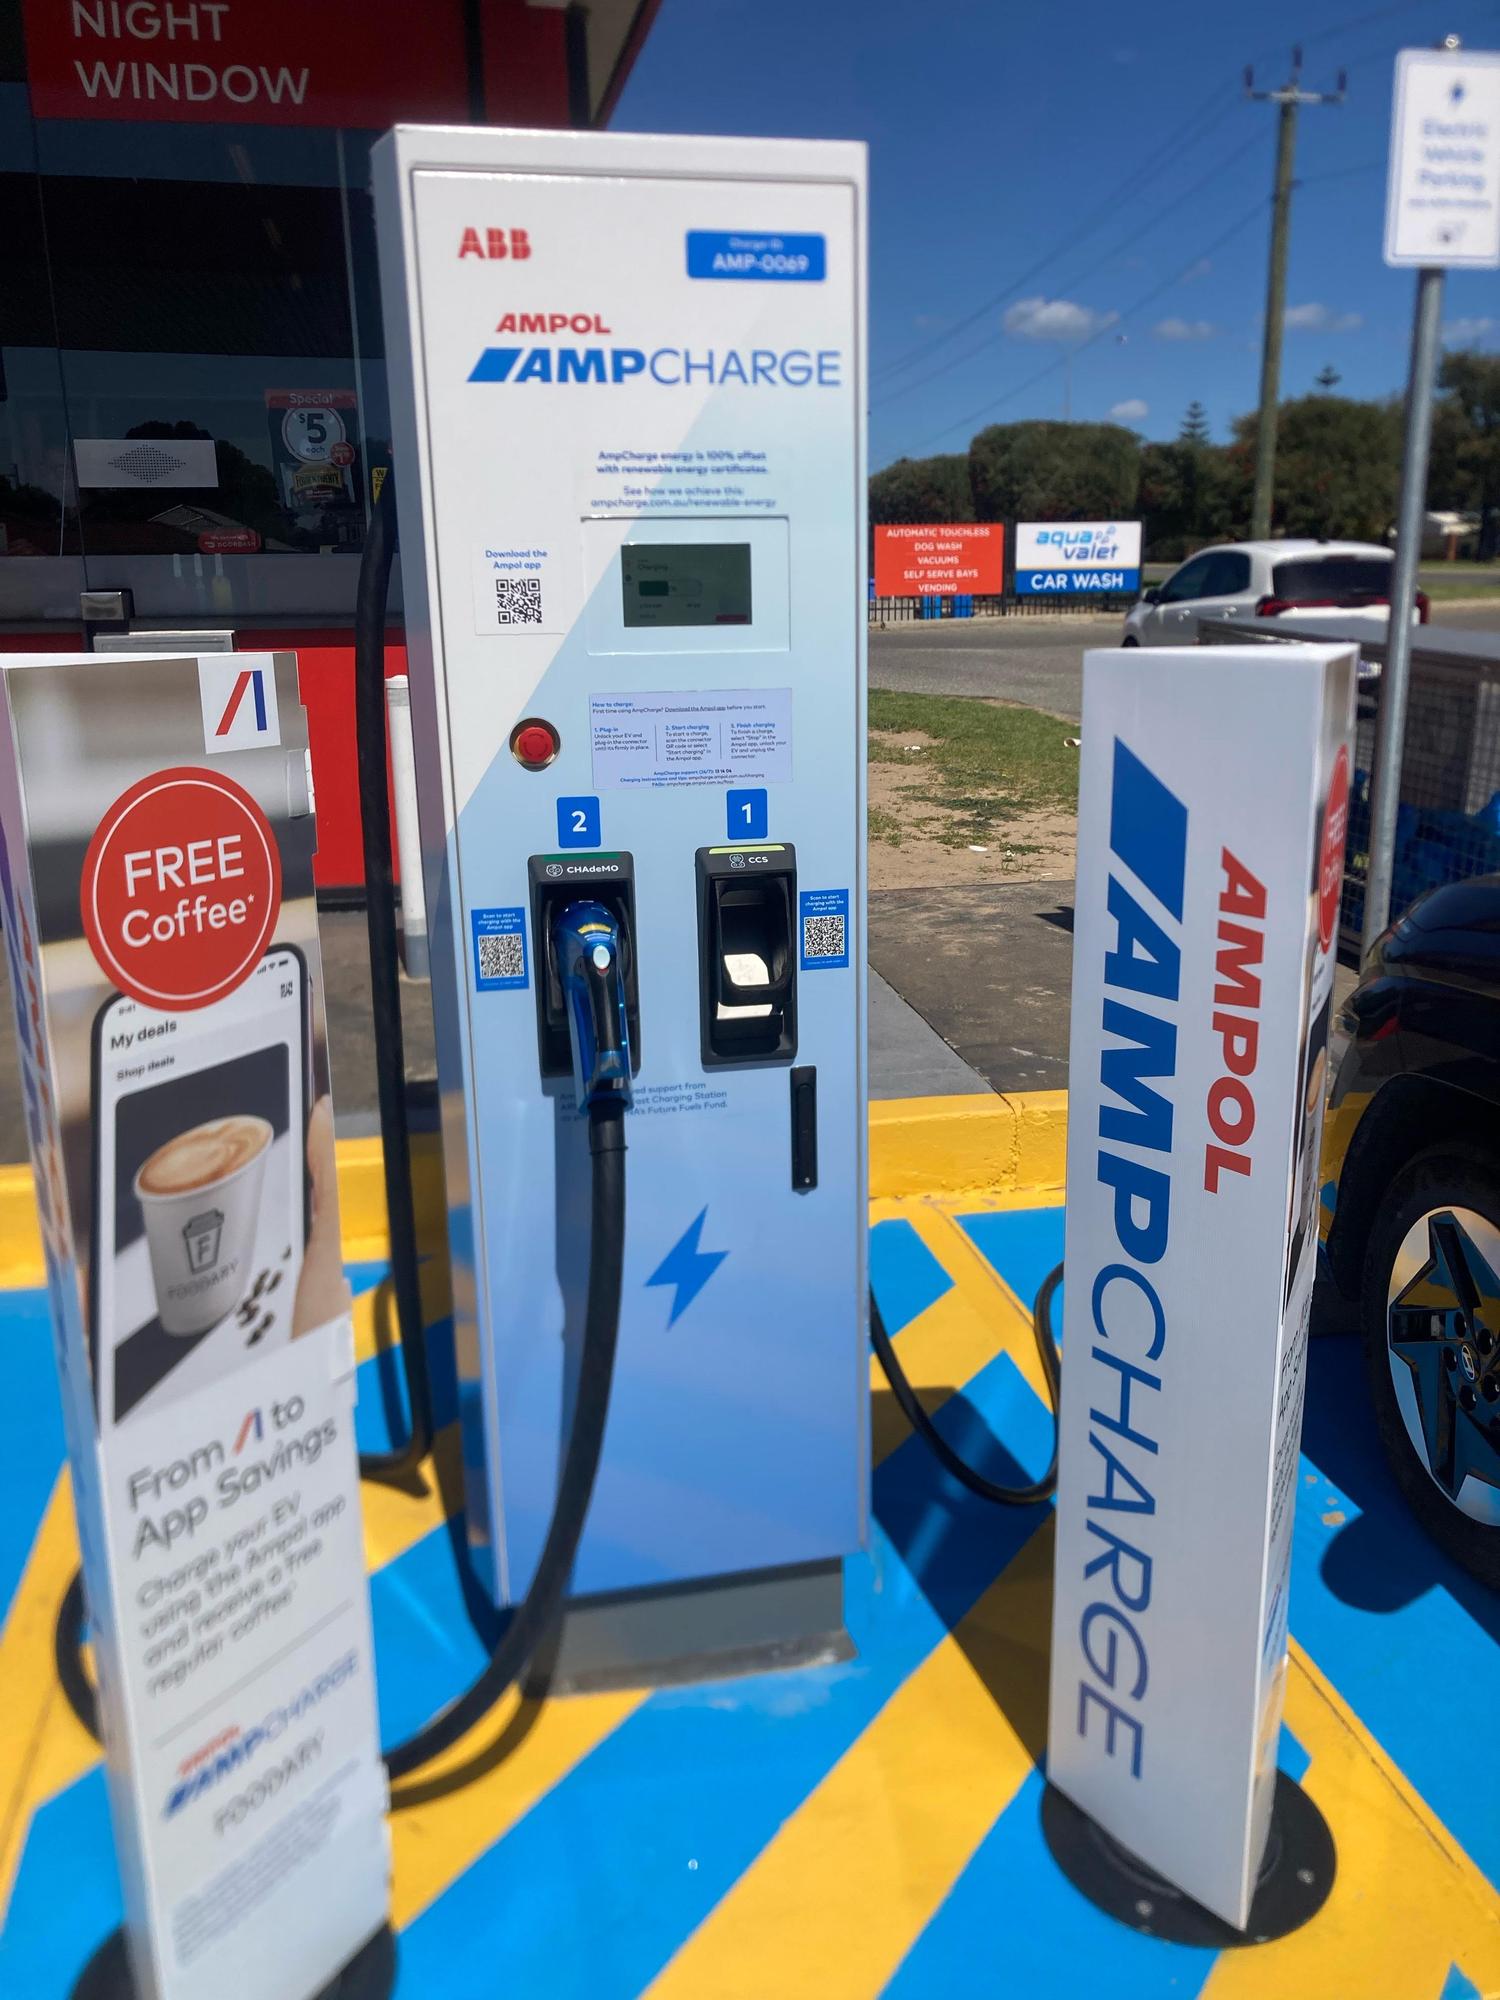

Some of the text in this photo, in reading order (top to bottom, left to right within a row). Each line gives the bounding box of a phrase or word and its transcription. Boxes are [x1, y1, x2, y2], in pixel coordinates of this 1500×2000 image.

[72, 0, 230, 41] NIGHT
[75, 61, 310, 104] WINDOW
[458, 227, 531, 260] ABB
[713, 252, 809, 274] AMP-0069
[495, 313, 611, 334] AMPOL
[513, 348, 841, 386] AMPCHARGE
[598, 451, 657, 462] AmpCharge
[887, 527, 990, 538] AUTOMATIC TOUCHLESS
[1035, 530, 1093, 547] aqua
[485, 549, 548, 559] Download the
[914, 541, 963, 551] DOG WASH
[1063, 544, 1119, 560] valet
[493, 560, 541, 572] Ampol app
[917, 556, 959, 565] VACUUMS
[904, 568, 978, 579] SELF SERVE BAYS
[1031, 573, 1124, 590] CAR WASH
[918, 583, 957, 593] VENDING
[572, 810, 587, 832] 2
[741, 803, 752, 824] 1
[123, 833, 245, 898] FREE
[566, 864, 619, 875] CHAdeMO
[748, 856, 769, 865] CCS
[1203, 845, 1268, 1194] AMPOL
[110, 1019, 177, 1049] My deals
[117, 1055, 175, 1081] Shop deals
[635, 1091, 728, 1105] ast Charging Station
[649, 1086, 682, 1096] support
[685, 1082, 706, 1091] from
[648, 1106, 677, 1114] Future
[679, 1103, 702, 1111] Fuels
[198, 1234, 210, 1263] F
[1076, 872, 1182, 1780] AMPCHARGE
[126, 1395, 305, 1512] From to
[132, 1416, 338, 1561] App Savings
[135, 1491, 302, 1609] Charge your EV
[140, 1493, 347, 1639] using the Ampol app
[143, 1539, 323, 1668] and receive a free
[146, 1637, 225, 1698] regular
[213, 1723, 326, 1842] FOODARY
